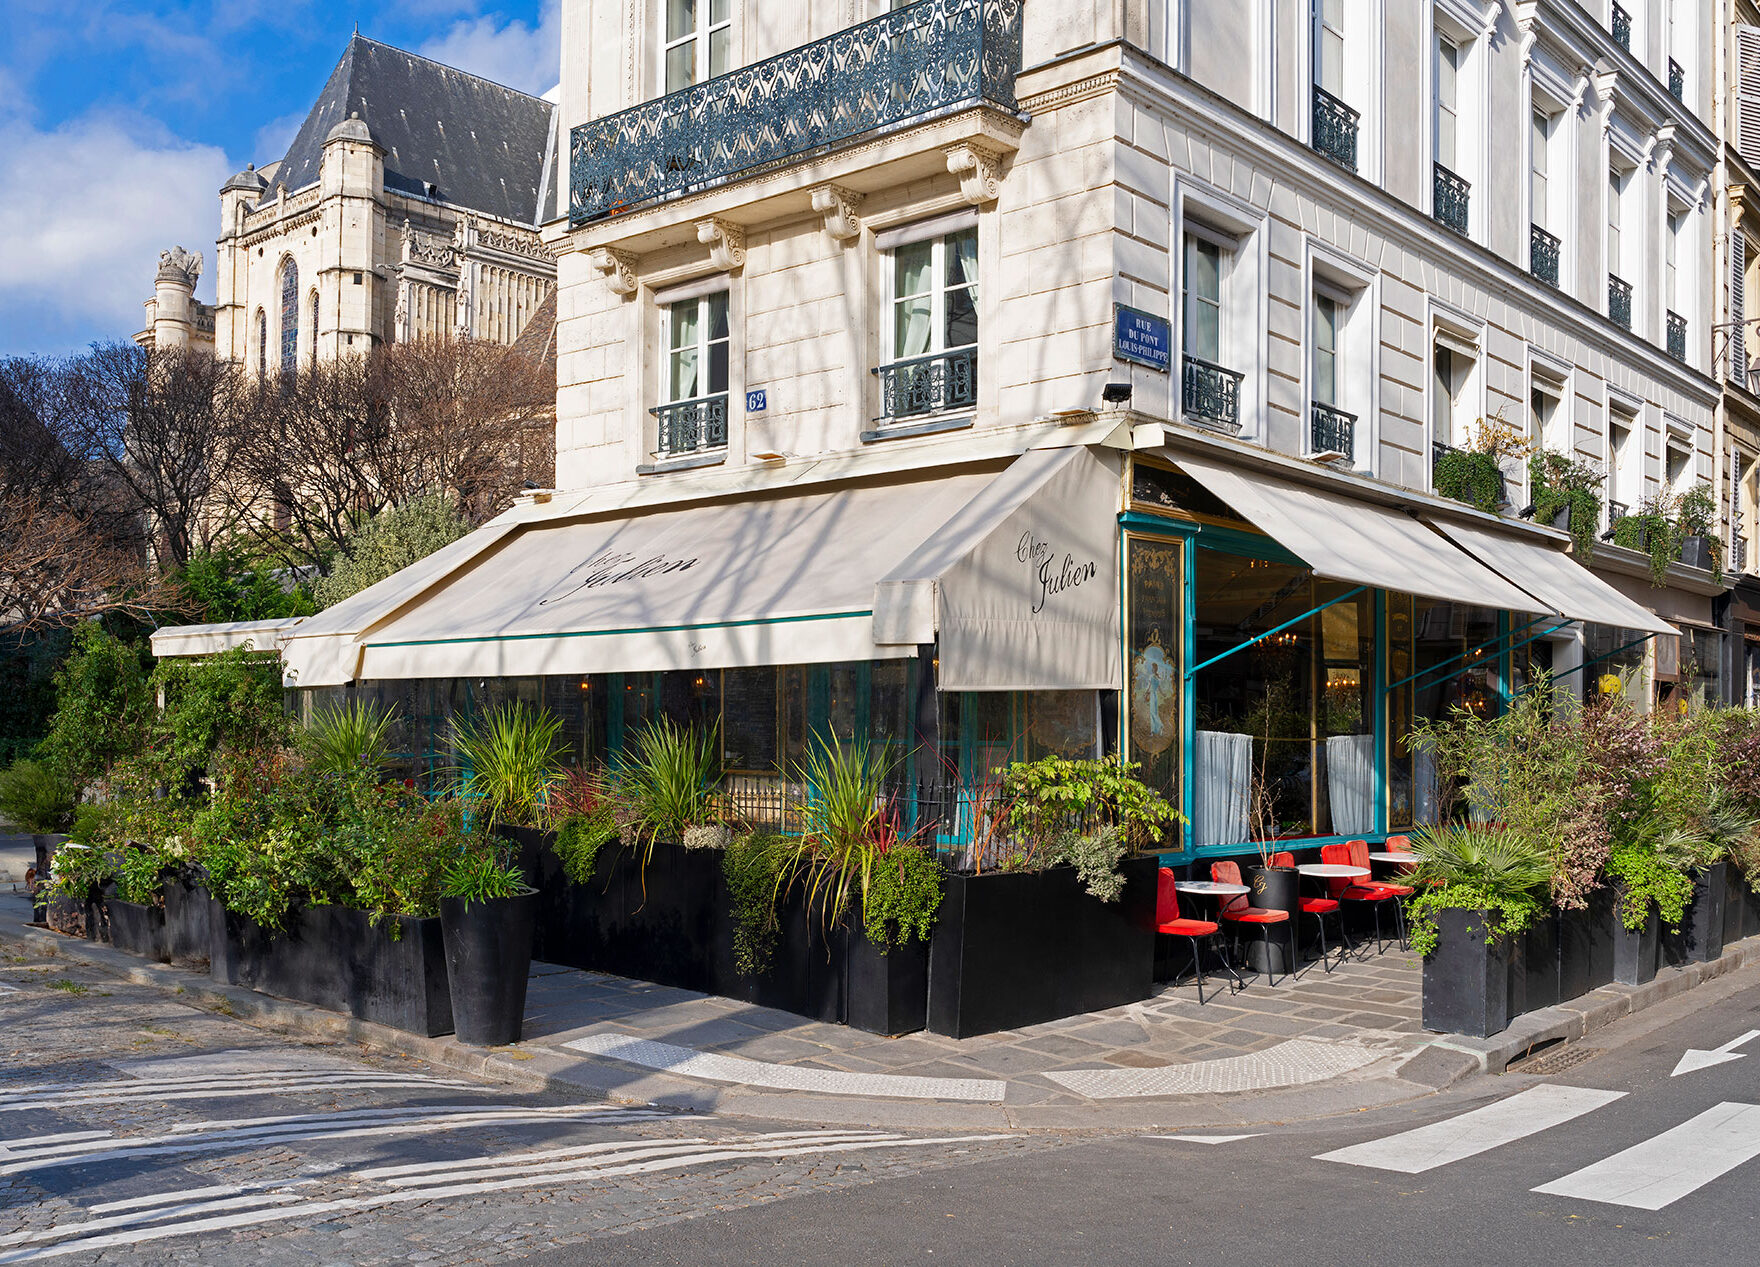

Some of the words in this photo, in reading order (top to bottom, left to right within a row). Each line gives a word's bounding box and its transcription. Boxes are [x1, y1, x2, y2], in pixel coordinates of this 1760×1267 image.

[1135, 319, 1152, 332] RUE
[1128, 328, 1139, 341] DU
[1140, 332, 1159, 347] PONT
[1118, 339, 1168, 361] LOUIS-PHILIPPE
[749, 392, 764, 410] 62
[1014, 530, 1048, 569] Chez
[1032, 553, 1097, 614] Julien
